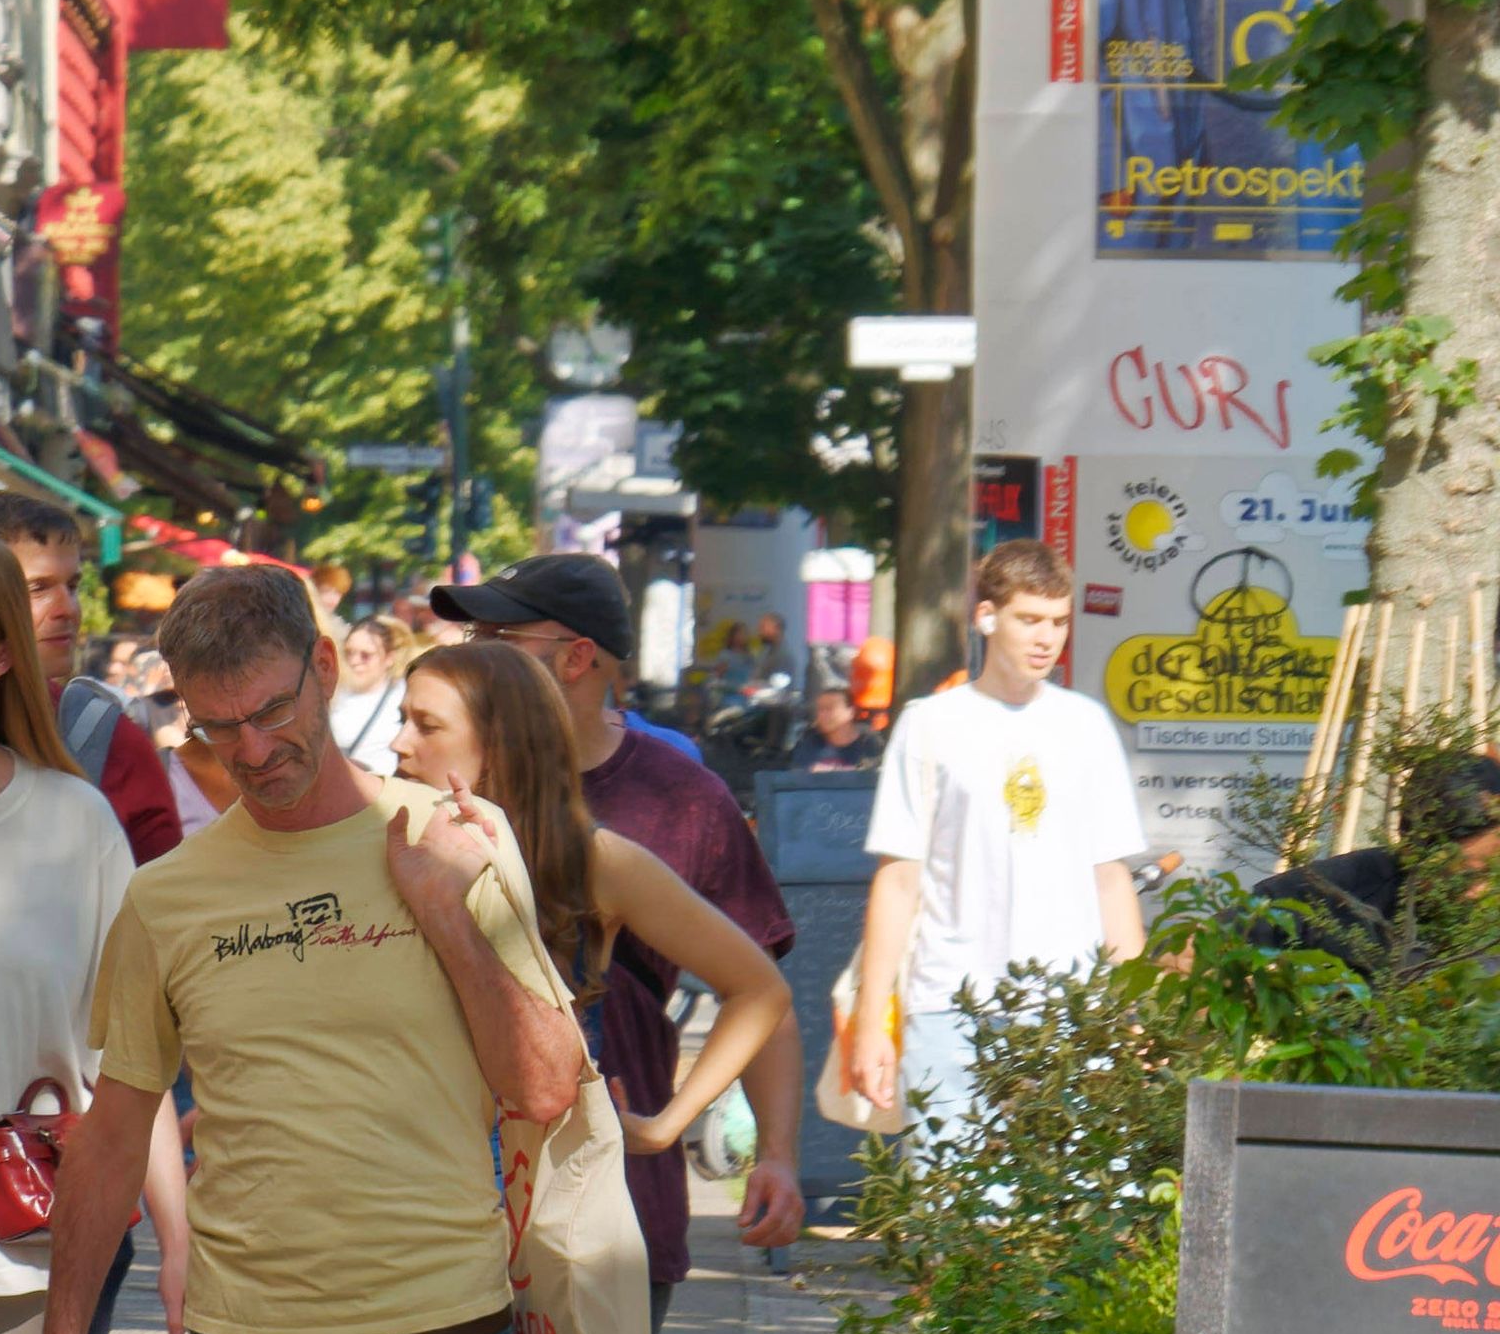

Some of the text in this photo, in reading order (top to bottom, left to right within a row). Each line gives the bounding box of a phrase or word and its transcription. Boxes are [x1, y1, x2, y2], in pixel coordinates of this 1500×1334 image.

[1125, 156, 1365, 204] Retrospekt
[1240, 498, 1286, 521] 21.
[1107, 478, 1188, 573] feiern verbindet
[1144, 726, 1209, 745] Tische
[1214, 726, 1250, 745] und
[1138, 776, 1165, 788] an
[212, 924, 309, 962] Billabong
[308, 922, 359, 948] South
[1410, 1297, 1480, 1317] ZERO
